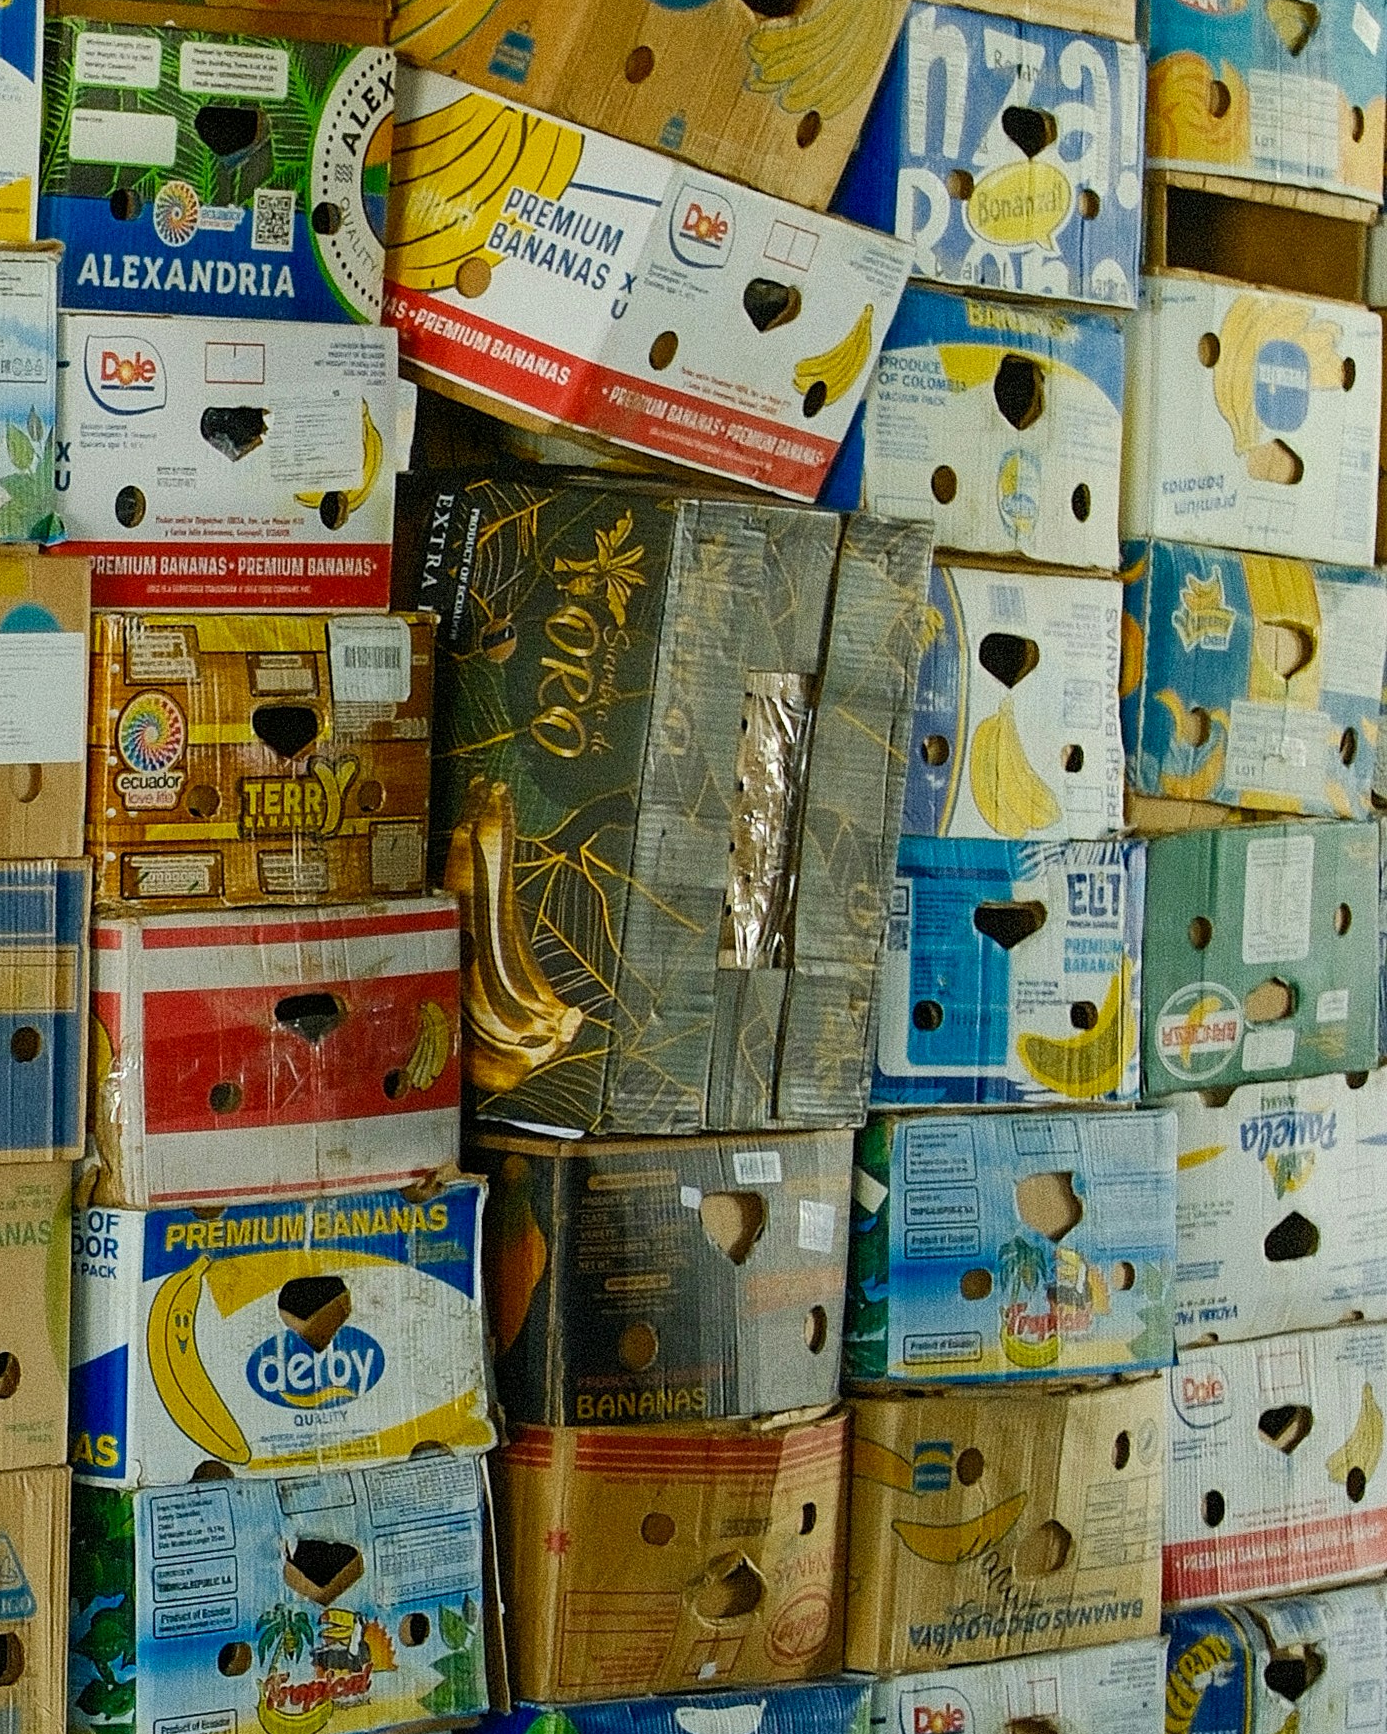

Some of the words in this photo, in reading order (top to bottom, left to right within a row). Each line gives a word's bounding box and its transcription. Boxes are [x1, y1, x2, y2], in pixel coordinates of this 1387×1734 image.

[501, 187, 624, 257] PREMIUM
[487, 221, 608, 292] BANANAS
[77, 255, 297, 299] ALEXANDRIA
[100, 350, 157, 388] Dole
[878, 372, 896, 388] OF
[877, 393, 916, 406] VACUUM
[919, 394, 946, 407] PACK
[89, 555, 156, 576] PREMIUM
[160, 555, 227, 576] BANANAS
[237, 557, 302, 576] PREMIUM
[307, 557, 372, 576] BANANAS
[531, 604, 601, 760] ORO
[1105, 606, 1122, 737] BANANAS
[119, 772, 182, 792] ecuador
[165, 1213, 304, 1251] PREMIUM
[313, 1204, 448, 1238] BANANAS
[81, 1264, 117, 1280] PACK
[293, 1410, 348, 1428] QUALITY
[576, 1386, 708, 1421] BANANAS
[266, 1666, 373, 1711] Tropical
